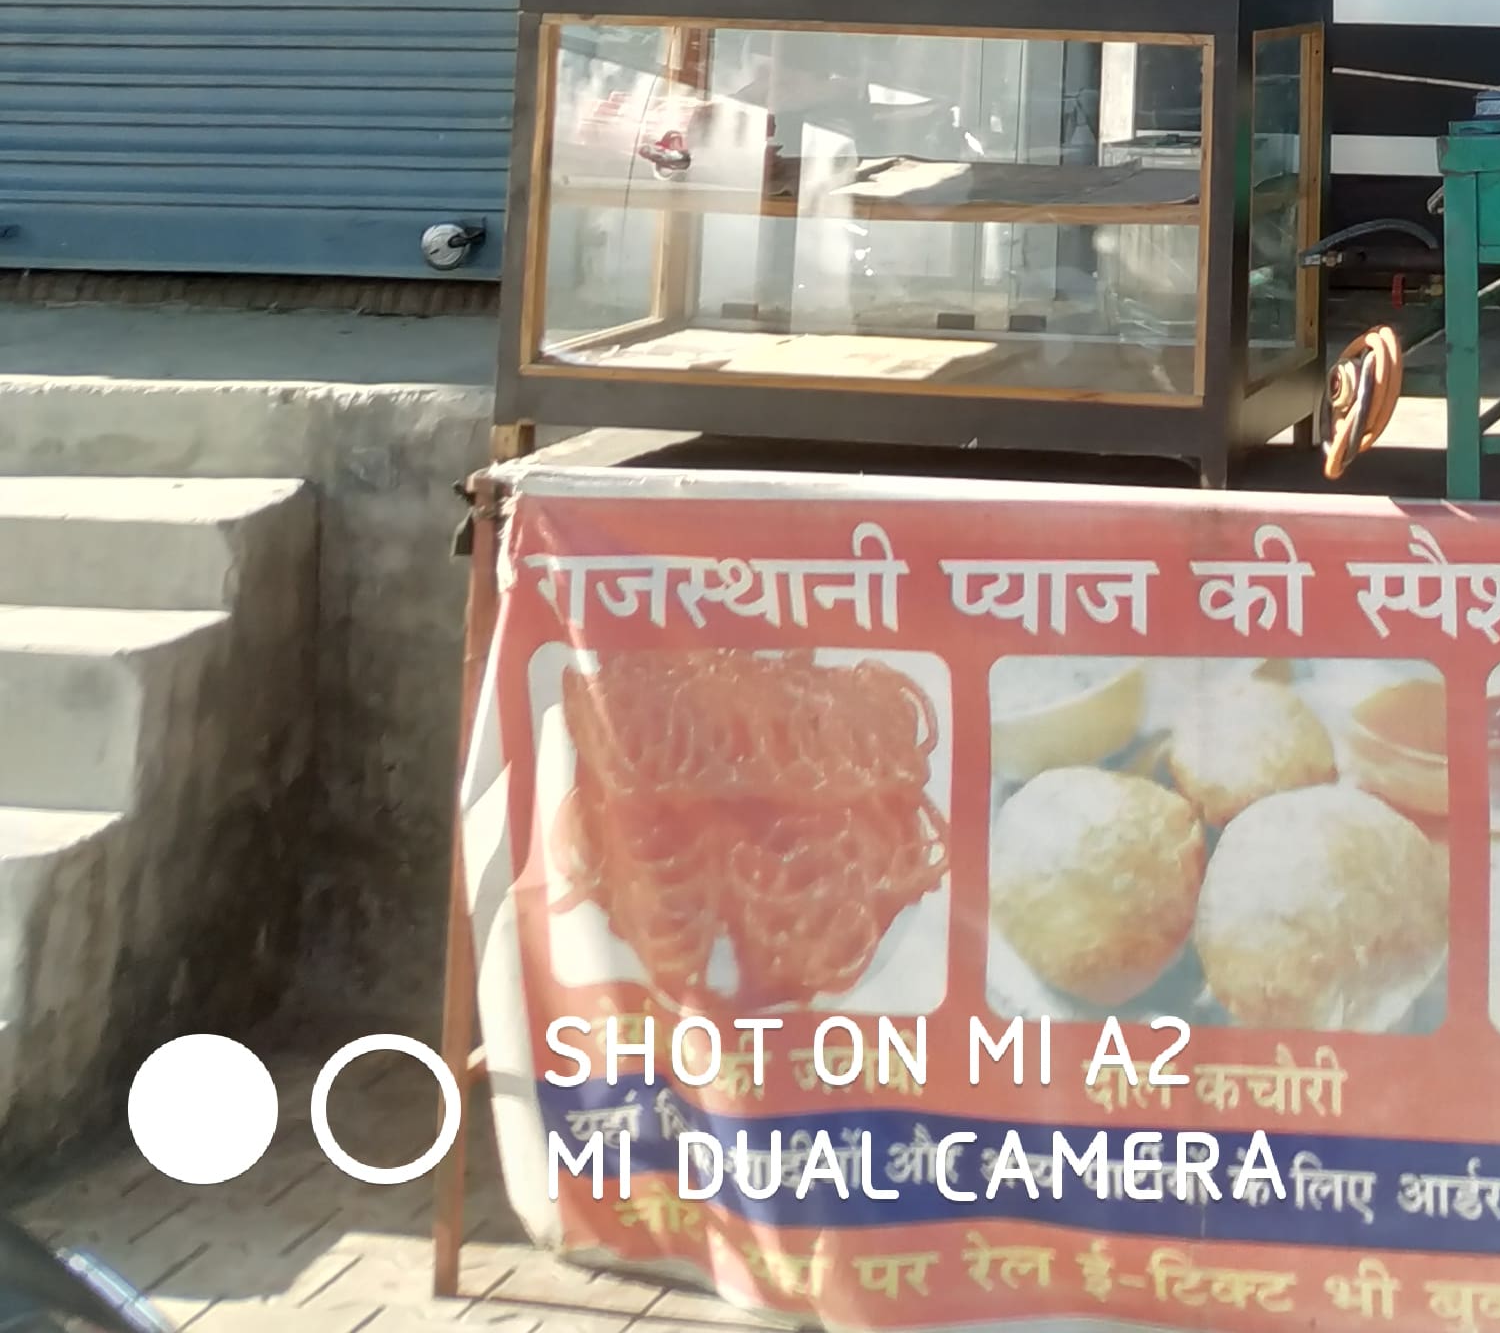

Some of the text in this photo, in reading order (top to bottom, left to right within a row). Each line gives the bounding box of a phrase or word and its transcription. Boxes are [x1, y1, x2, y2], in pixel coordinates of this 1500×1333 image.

[938, 559, 1158, 636] प्याज
[1191, 524, 1316, 639] की
[1290, 1150, 1377, 1225] लिए
[853, 1251, 940, 1299] पर
[963, 1232, 1057, 1293] रेल
[1324, 1258, 1399, 1320] भी
